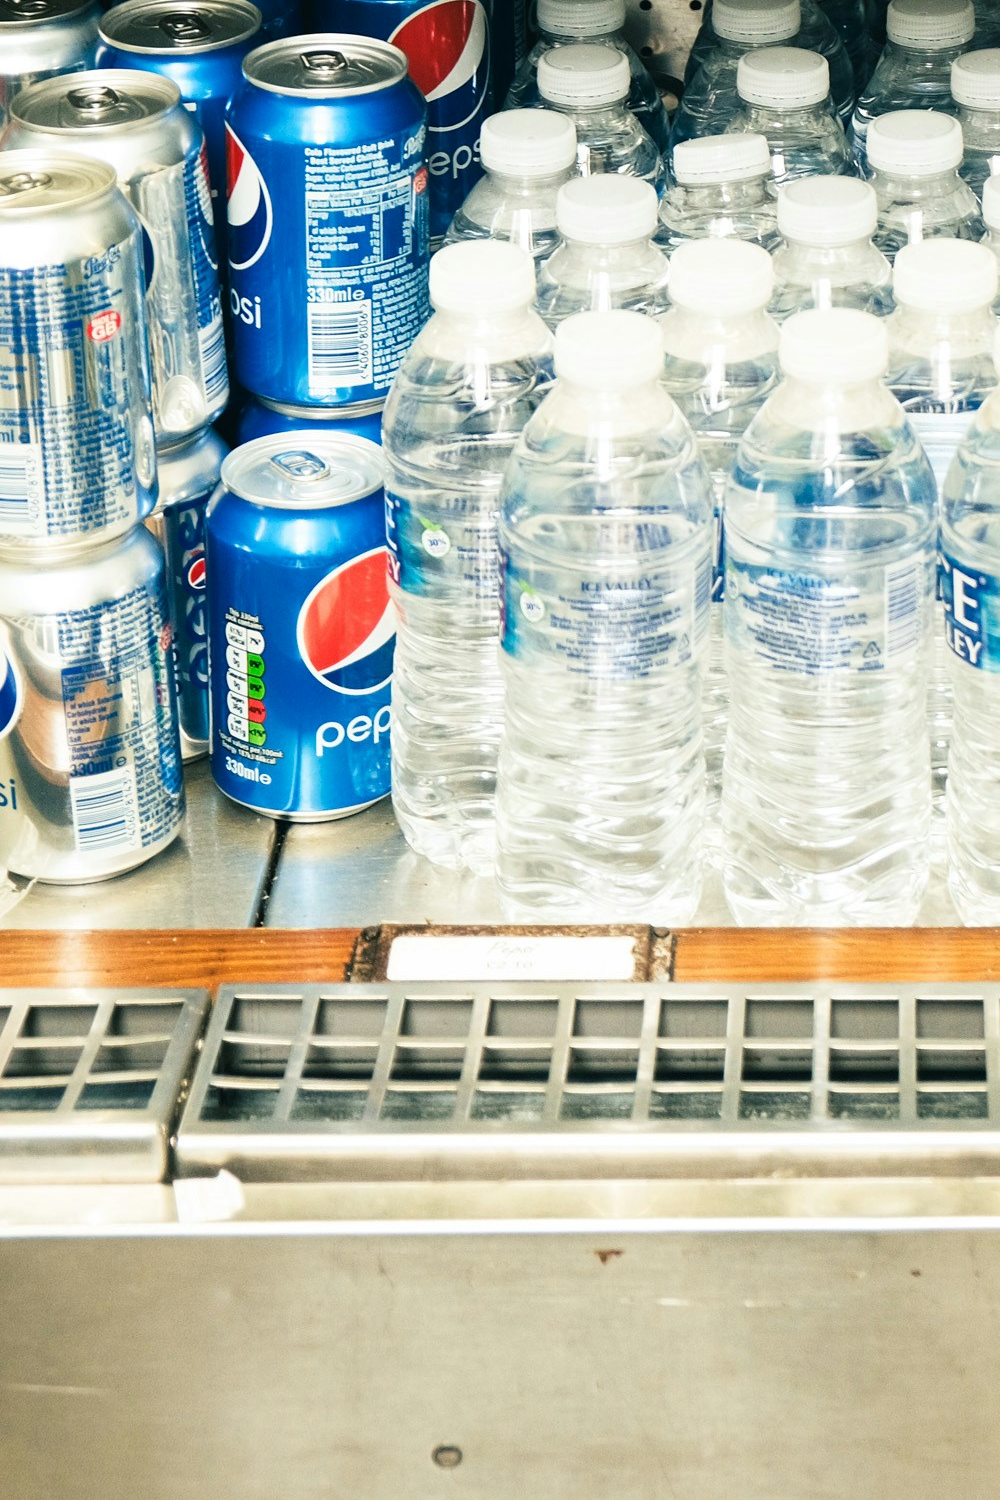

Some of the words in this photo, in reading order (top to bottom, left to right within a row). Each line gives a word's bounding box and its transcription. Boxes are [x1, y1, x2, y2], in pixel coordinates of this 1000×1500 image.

[91, 320, 117, 340] GB
[581, 581, 600, 592] ICE
[605, 577, 651, 591] VALLEY
[70, 755, 114, 779] 330ml
[225, 755, 259, 783] 330ml
